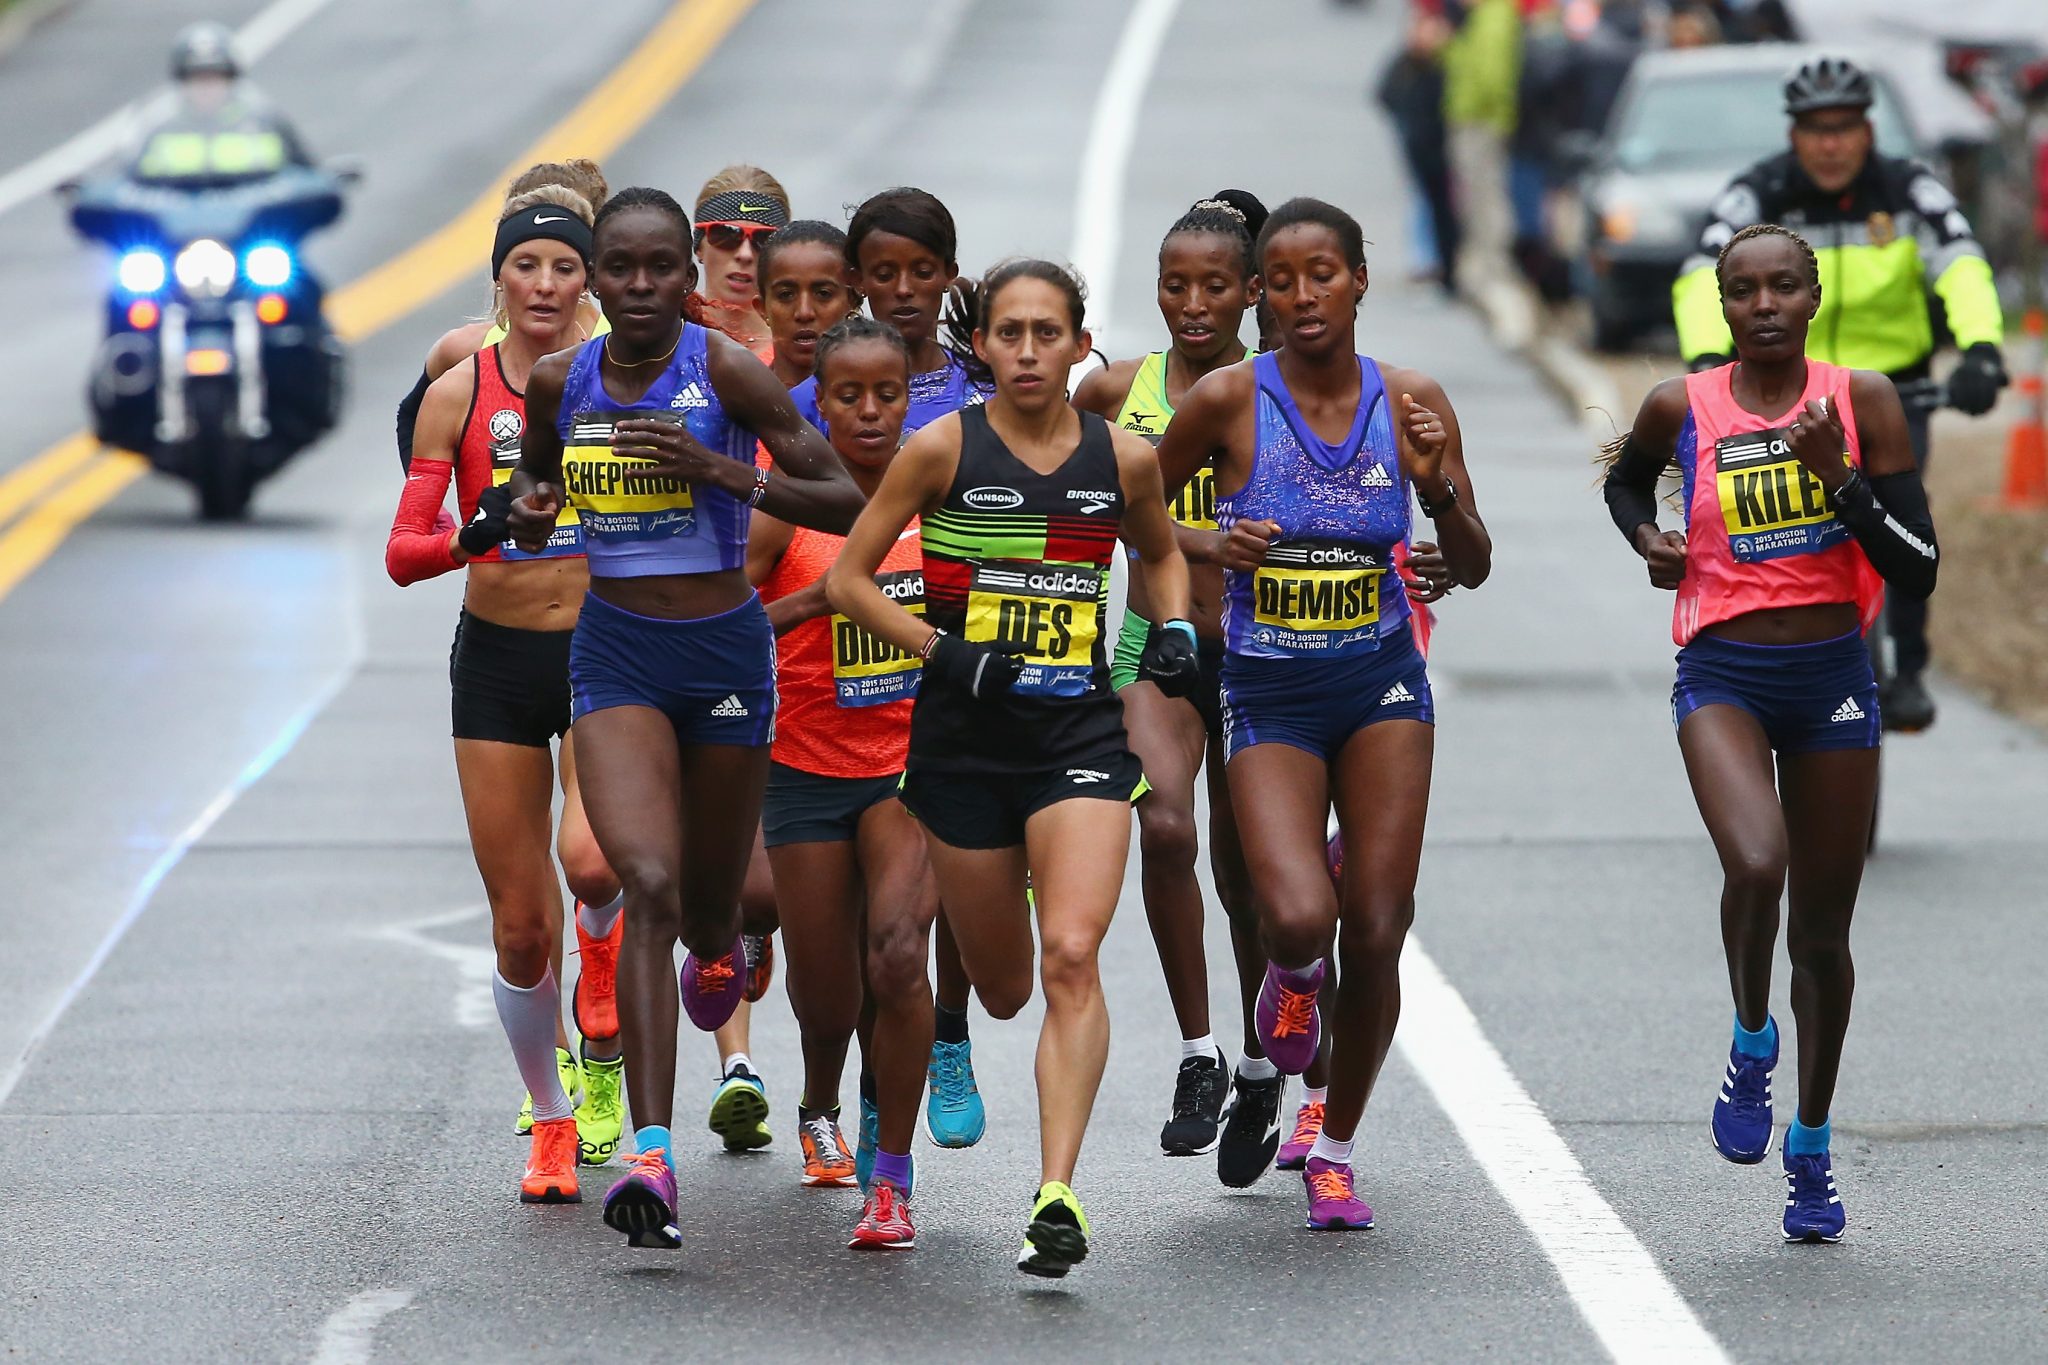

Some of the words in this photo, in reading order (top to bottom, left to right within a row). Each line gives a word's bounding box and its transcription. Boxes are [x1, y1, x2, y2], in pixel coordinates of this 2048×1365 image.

[671, 398, 709, 408] adidas
[1361, 478, 1393, 487] adidas
[969, 493, 1018, 503] HANSONS
[1066, 490, 1117, 501] BROOKS
[1733, 463, 1832, 528] KILE
[607, 517, 639, 525] BOSTON
[593, 522, 640, 533] MARATHON
[550, 529, 575, 539] STON
[1755, 535, 1772, 544] 2015
[1774, 529, 1806, 540] BOSTON
[546, 537, 576, 547] ATHON
[1755, 536, 1808, 552] MARATHON
[882, 577, 924, 598] adid
[1028, 572, 1099, 594] adidas
[1260, 574, 1376, 620] DEMISE
[998, 599, 1072, 659] DES
[1278, 631, 1295, 640] 2015
[1277, 639, 1328, 649] MARATHON
[861, 680, 878, 688] 2015
[879, 675, 904, 686] BOSTON
[861, 682, 904, 696] MARATHON
[1380, 694, 1415, 705] adidas
[711, 708, 748, 716] adidas
[1831, 711, 1865, 722] adidas
[1066, 769, 1110, 779] BROOKS
